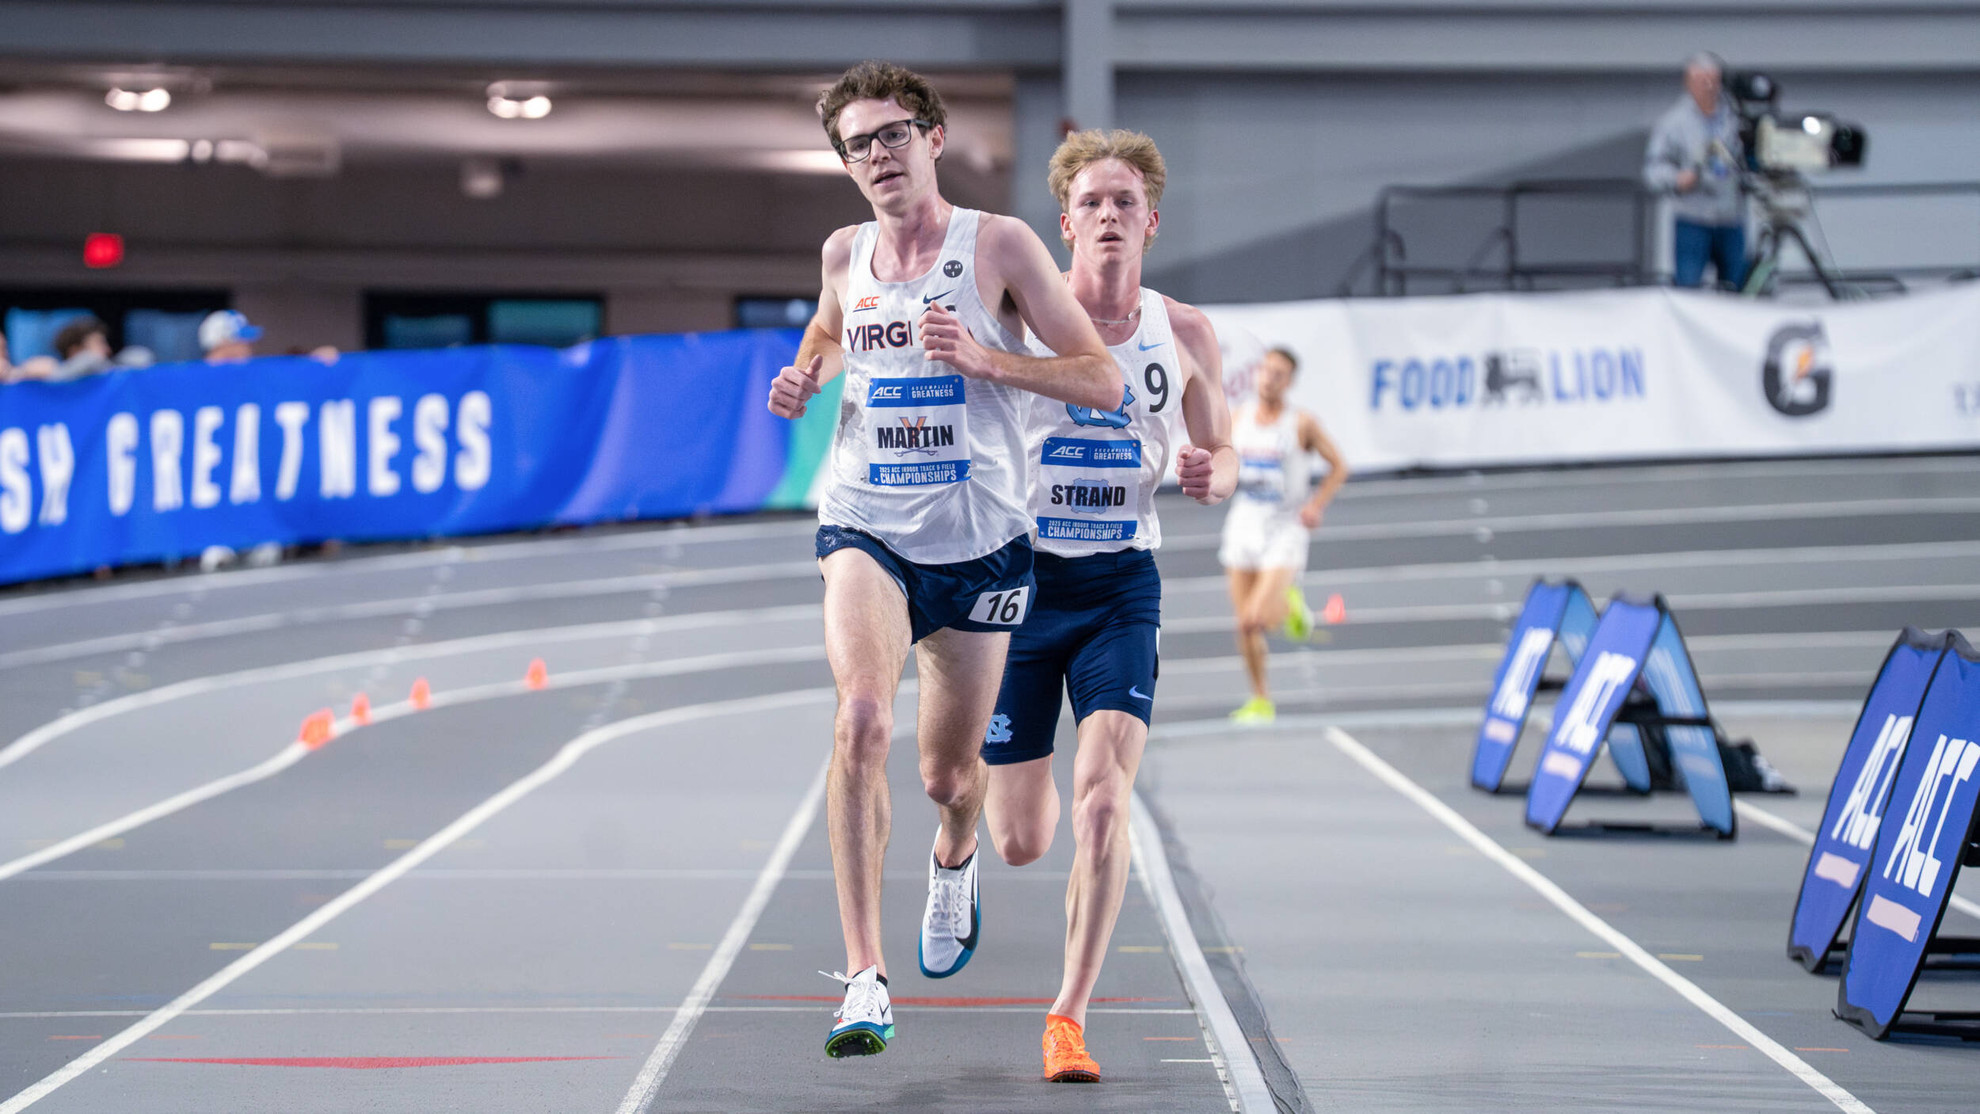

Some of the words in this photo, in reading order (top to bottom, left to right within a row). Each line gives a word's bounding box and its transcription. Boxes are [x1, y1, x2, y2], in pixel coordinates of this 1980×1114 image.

[855, 296, 880, 309] ACC
[846, 320, 914, 353] VIRGI
[1371, 357, 1475, 410] FOOD
[1551, 346, 1646, 401] LION
[1763, 322, 1833, 417] G
[872, 386, 903, 397] ACC
[911, 389, 954, 399] GREATNESS
[1144, 362, 1169, 413] 9
[877, 424, 955, 449] MARTIN
[105, 388, 492, 518] GREATNESS
[1052, 446, 1086, 456] ACC
[1093, 452, 1133, 460] GREATNESS
[880, 469, 958, 485] CHAMPIONSHIPS
[901, 465, 919, 473] INDOOR
[920, 464, 936, 472] TRACK
[1051, 484, 1126, 507] STRAND
[1047, 526, 1123, 540] CHAMPIONSHIPS
[1072, 521, 1090, 529] INDOOR
[1090, 522, 1105, 530] TRACK
[986, 590, 1021, 623] 16
[1554, 651, 1637, 754] ACC
[1831, 713, 1914, 850] ACC
[1883, 733, 1980, 898] ACC
